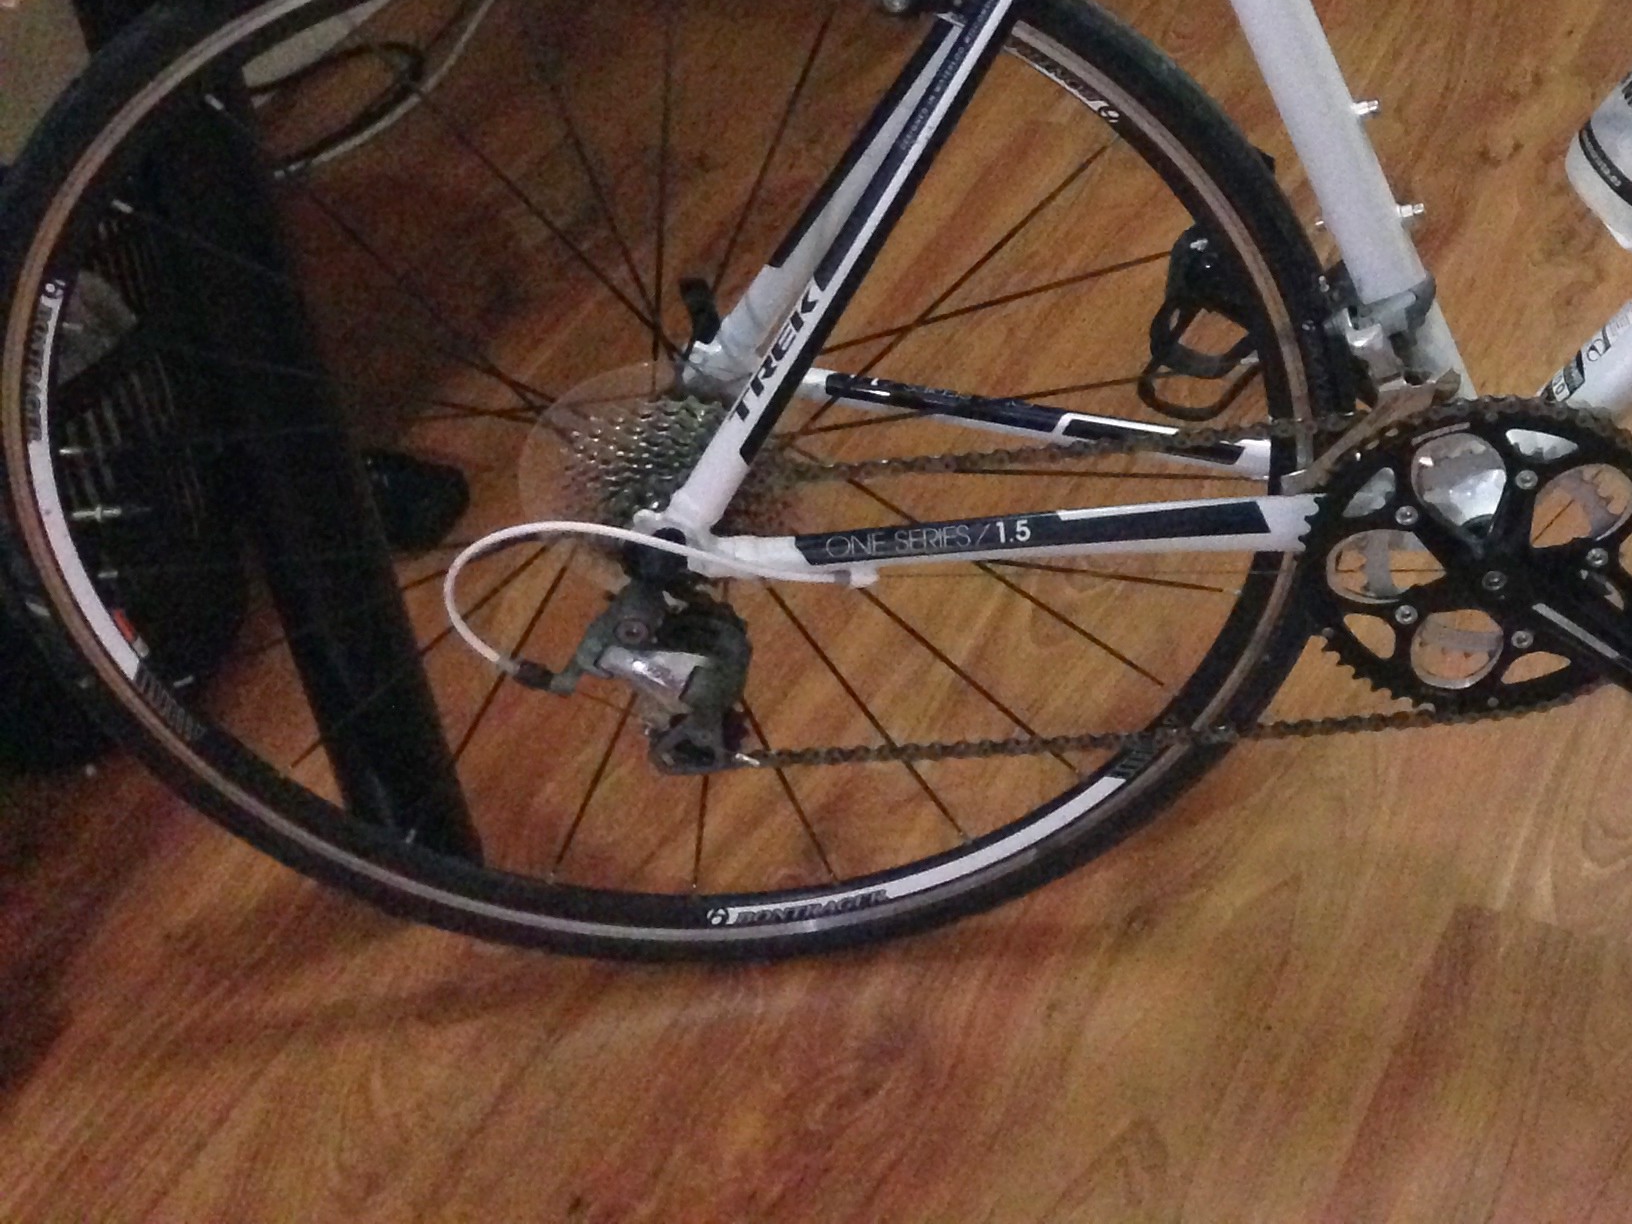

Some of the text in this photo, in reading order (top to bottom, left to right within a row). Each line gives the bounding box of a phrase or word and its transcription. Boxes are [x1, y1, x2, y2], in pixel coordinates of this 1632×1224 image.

[727, 287, 819, 422] TREK
[825, 531, 886, 559] ONE
[893, 524, 972, 555] SERIES
[995, 519, 1032, 545] 1.5
